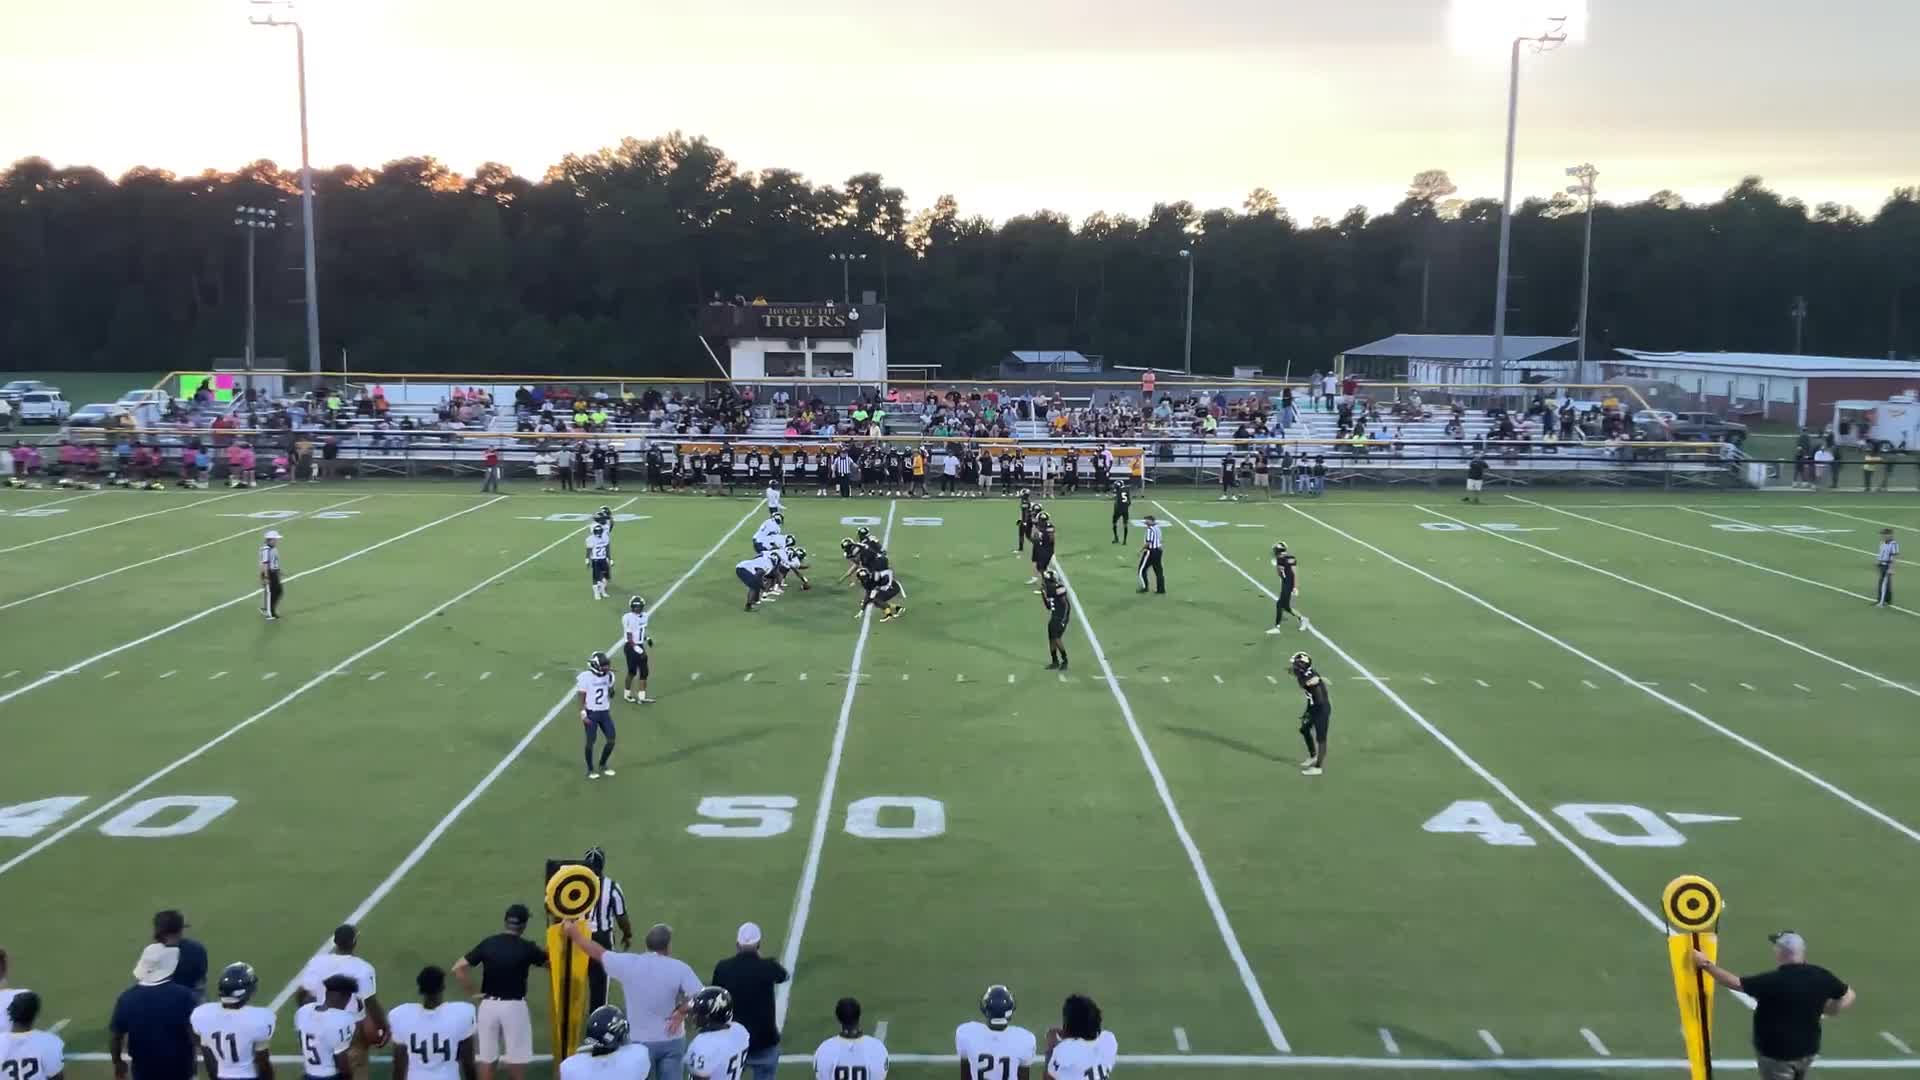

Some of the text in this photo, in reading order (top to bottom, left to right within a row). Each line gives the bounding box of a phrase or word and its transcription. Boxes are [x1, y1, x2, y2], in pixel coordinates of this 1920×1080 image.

[761, 314, 847, 328] TIGERS
[1120, 492, 1129, 503] 5
[594, 688, 605, 706] 2
[686, 796, 948, 840] 50
[1421, 800, 1688, 846] 40
[211, 1031, 240, 1064] 11
[410, 1032, 452, 1064] 44
[1, 1057, 39, 1080] 32
[978, 1054, 1011, 1080] 21
